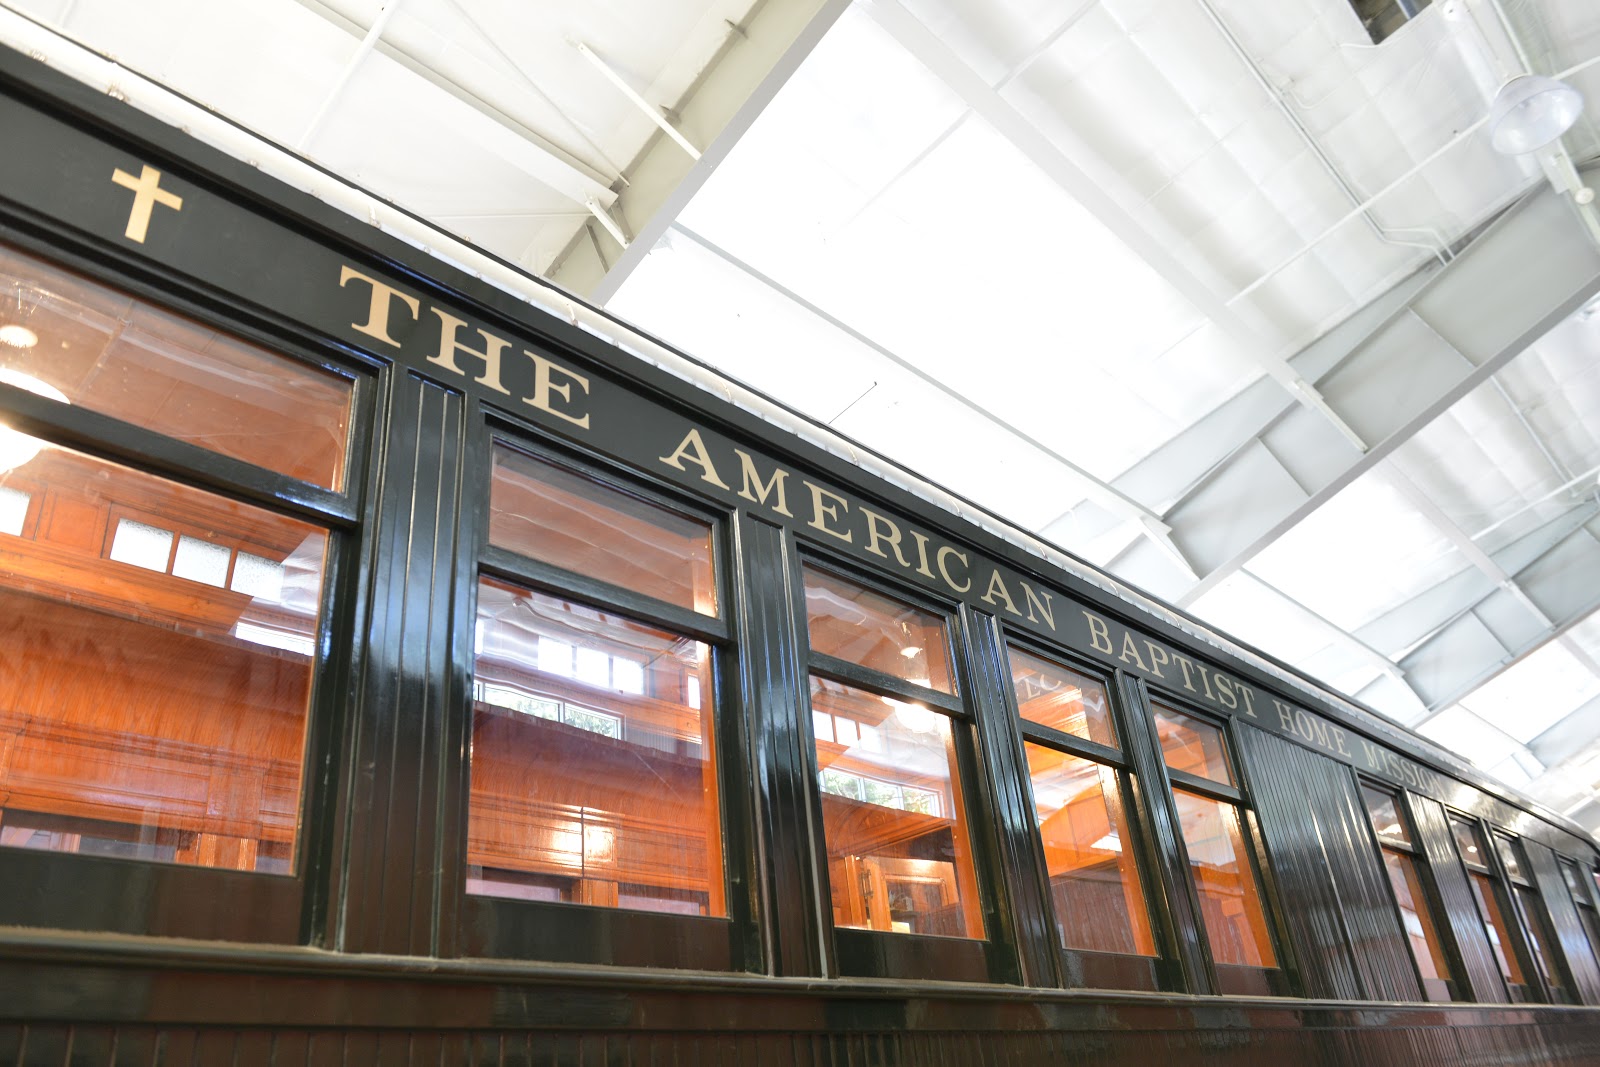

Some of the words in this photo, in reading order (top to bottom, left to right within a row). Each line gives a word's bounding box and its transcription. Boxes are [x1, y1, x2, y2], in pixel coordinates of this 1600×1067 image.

[340, 264, 590, 430] THE
[659, 428, 1056, 631] AMERICAN
[1082, 611, 1257, 718] BAPTIST
[1272, 699, 1352, 758] HOME
[1360, 739, 1447, 800] MISSION
